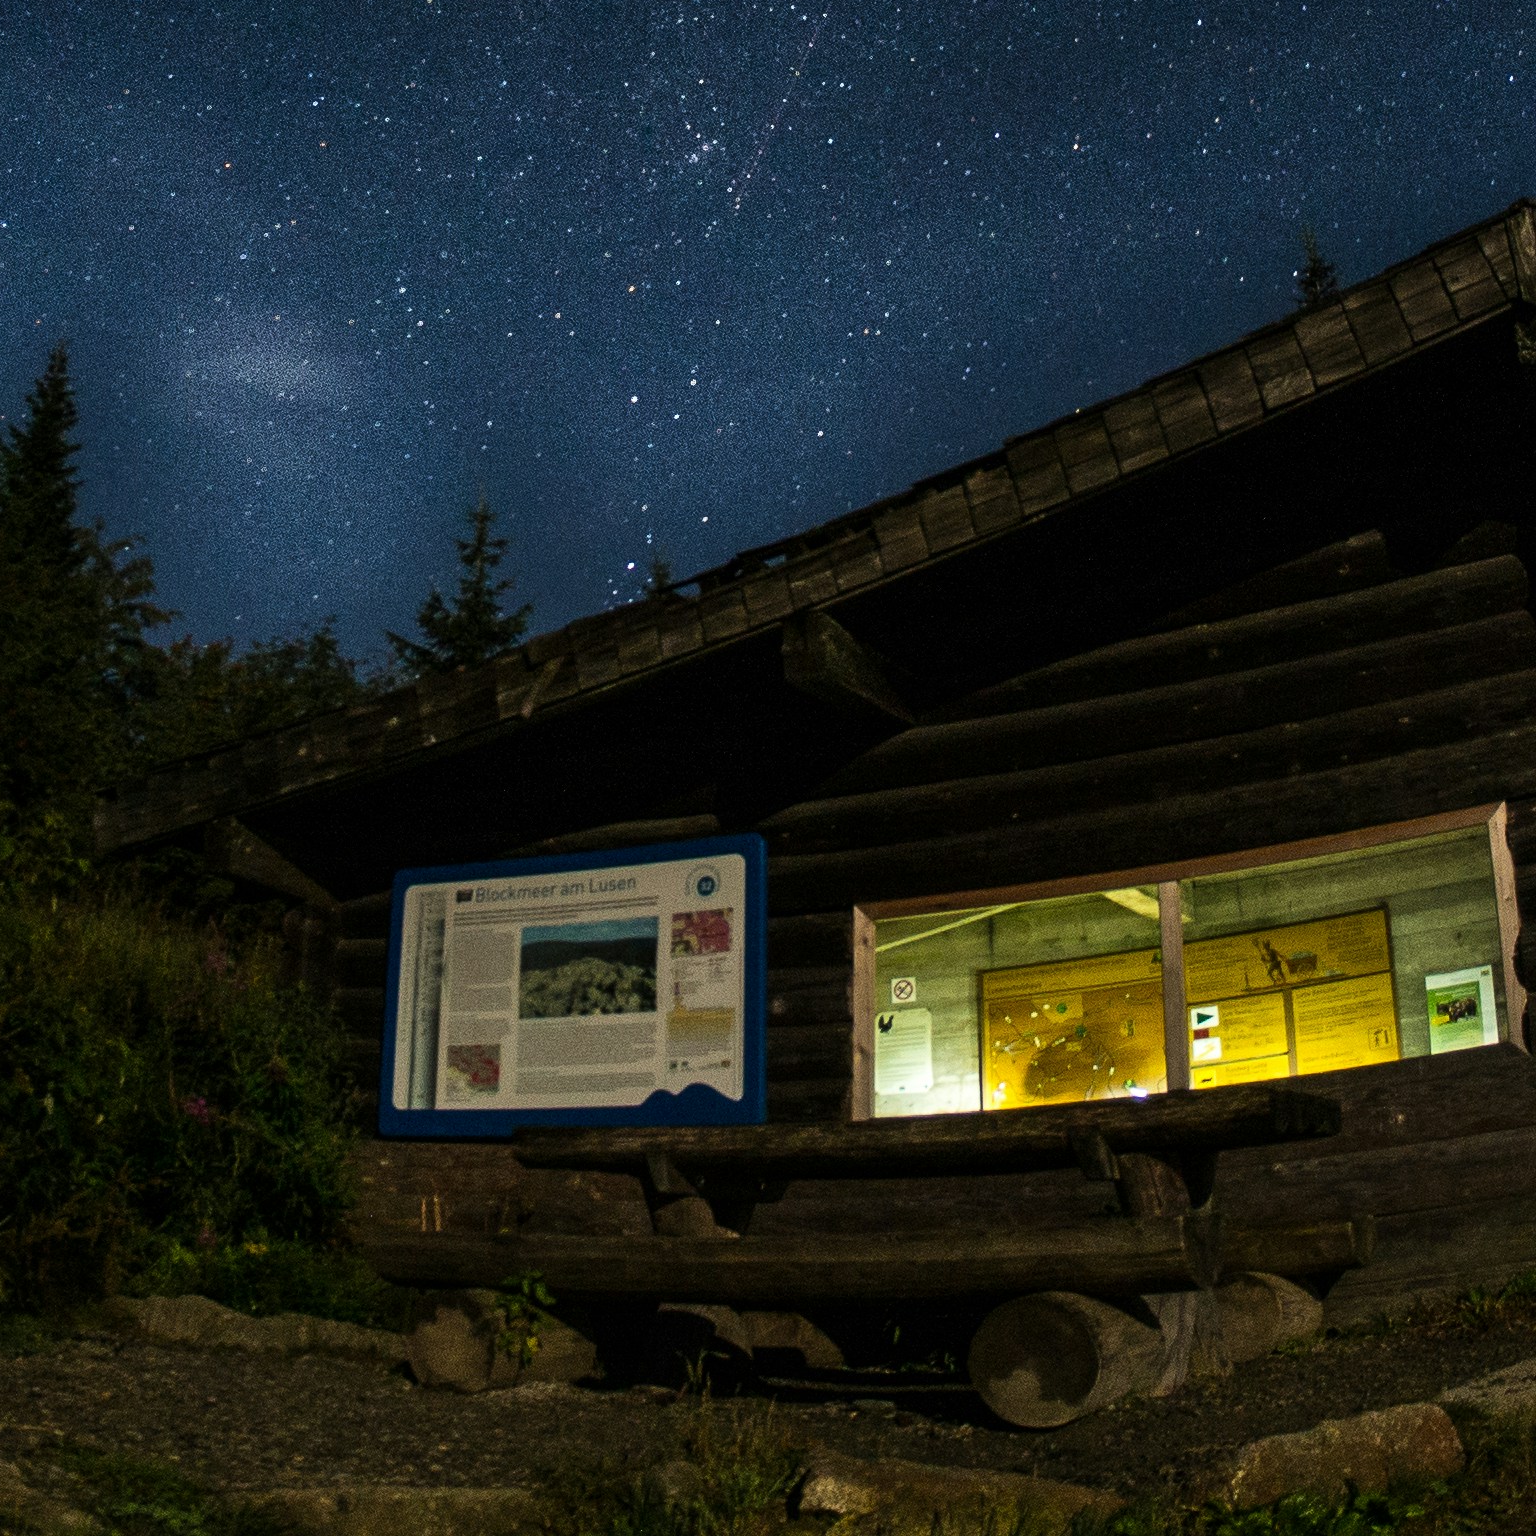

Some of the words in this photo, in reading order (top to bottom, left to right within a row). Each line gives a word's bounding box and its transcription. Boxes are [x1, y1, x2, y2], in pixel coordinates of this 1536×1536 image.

[475, 885, 556, 904] Blockmeer
[560, 881, 584, 895] am
[588, 876, 637, 894] Lusen
